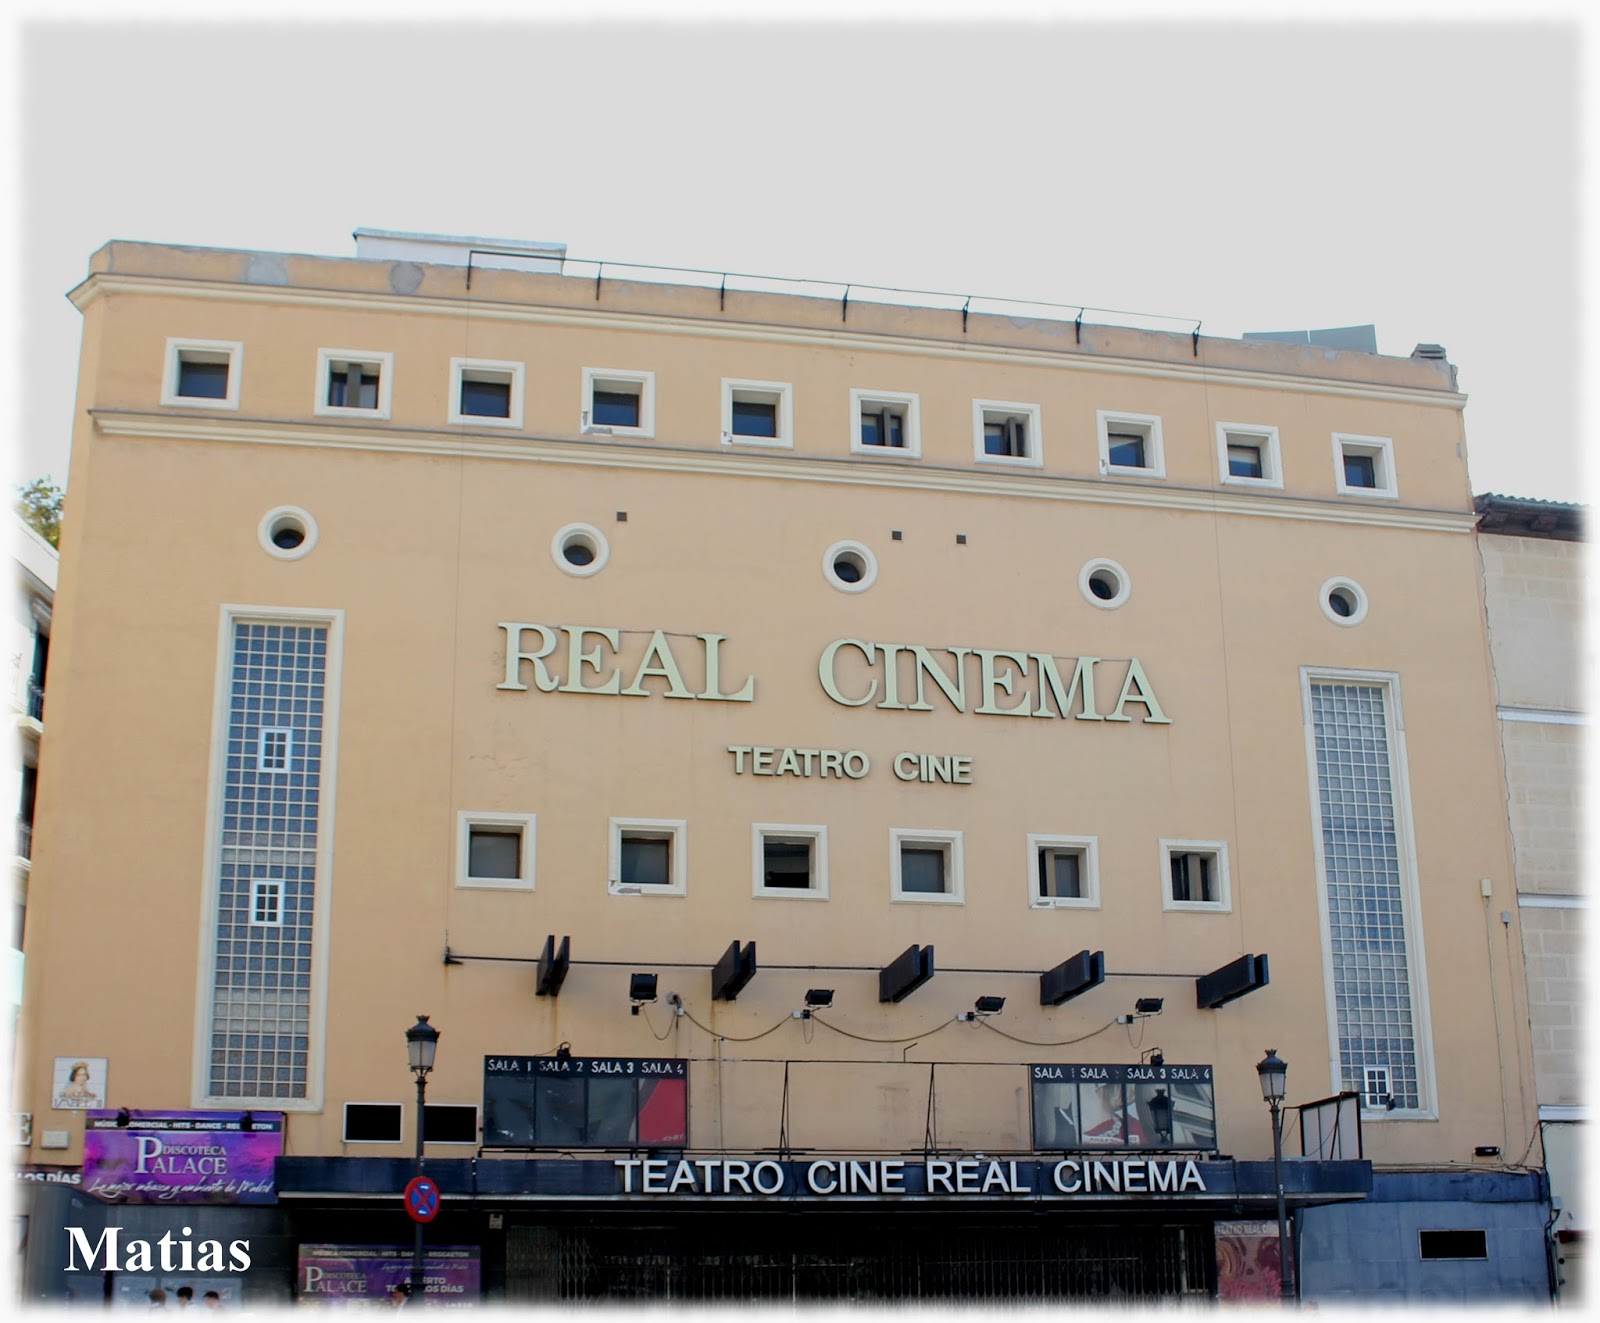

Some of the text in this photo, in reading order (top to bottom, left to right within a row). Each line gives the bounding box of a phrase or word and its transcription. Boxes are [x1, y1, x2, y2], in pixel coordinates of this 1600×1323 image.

[496, 622, 1173, 724] REAL CINEMA
[727, 745, 975, 785] TEATRO CINE
[488, 1059, 520, 1072] SALA
[539, 1060, 571, 1073] SALA
[576, 1061, 583, 1073] 2
[591, 1061, 623, 1074] SALA
[626, 1061, 635, 1074] 3
[641, 1062, 673, 1075] SALA
[1034, 1067, 1064, 1079] SALA
[1080, 1067, 1109, 1080] SALA
[1126, 1068, 1156, 1080] SALA
[1159, 1068, 1167, 1080] 3
[1170, 1068, 1199, 1080] SALA
[1203, 1068, 1210, 1079] 4
[94, 1119, 118, 1128] MÚSIC
[126, 1121, 168, 1129] OMERCIAL
[195, 1122, 222, 1130] DANCE
[133, 1136, 227, 1175] PALACE
[162, 1145, 227, 1156] DISCOTECA
[46, 1171, 82, 1184] DÍAS
[614, 1160, 1206, 1194] TEATRO CINE REAL CINEMA
[304, 1266, 368, 1293] PALACE
[404, 1277, 446, 1285] AERTO
[441, 1285, 464, 1293] DÍAS
